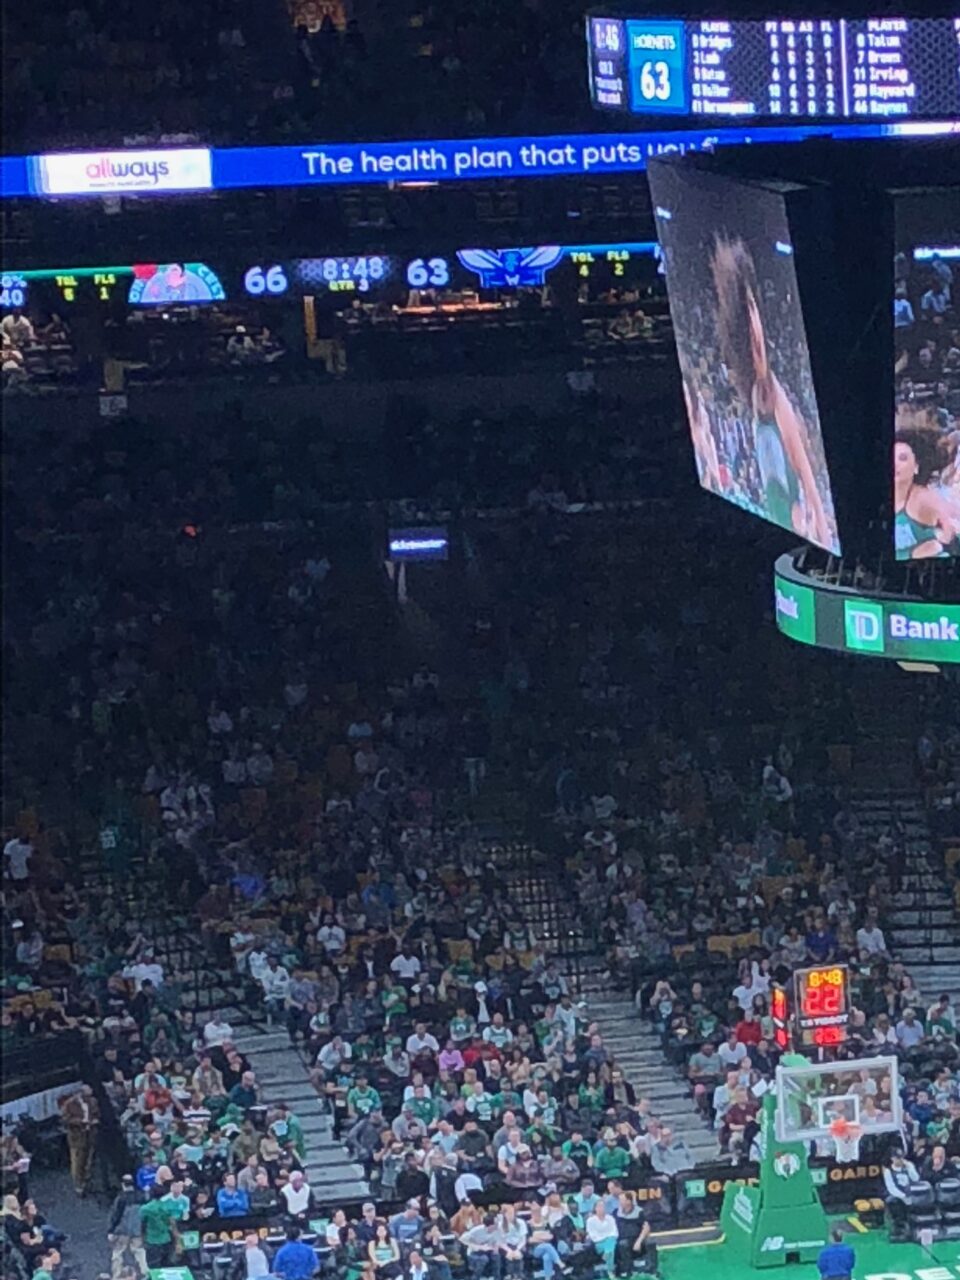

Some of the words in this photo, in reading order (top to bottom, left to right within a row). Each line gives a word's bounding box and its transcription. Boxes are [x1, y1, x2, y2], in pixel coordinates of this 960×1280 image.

[868, 20, 908, 31] PLAYER
[633, 34, 676, 50] HORNETS
[858, 51, 864, 63] 7
[640, 61, 671, 100] 63
[854, 68, 865, 80] 11
[870, 67, 908, 83] Irving
[302, 152, 353, 175] The
[361, 148, 447, 173] health
[455, 146, 512, 176] plan
[520, 144, 576, 166] that
[583, 143, 641, 170] puts
[86, 158, 170, 185] allways
[323, 256, 384, 280] 8:48
[407, 258, 449, 286] 63
[579, 264, 589, 277] 4
[615, 263, 624, 276] 2
[244, 265, 288, 294] 66
[358, 278, 369, 292] 3
[101, 287, 109, 300] 1
[849, 610, 879, 641] TD
[890, 613, 960, 641] Bank
[806, 985, 841, 1013] 22
